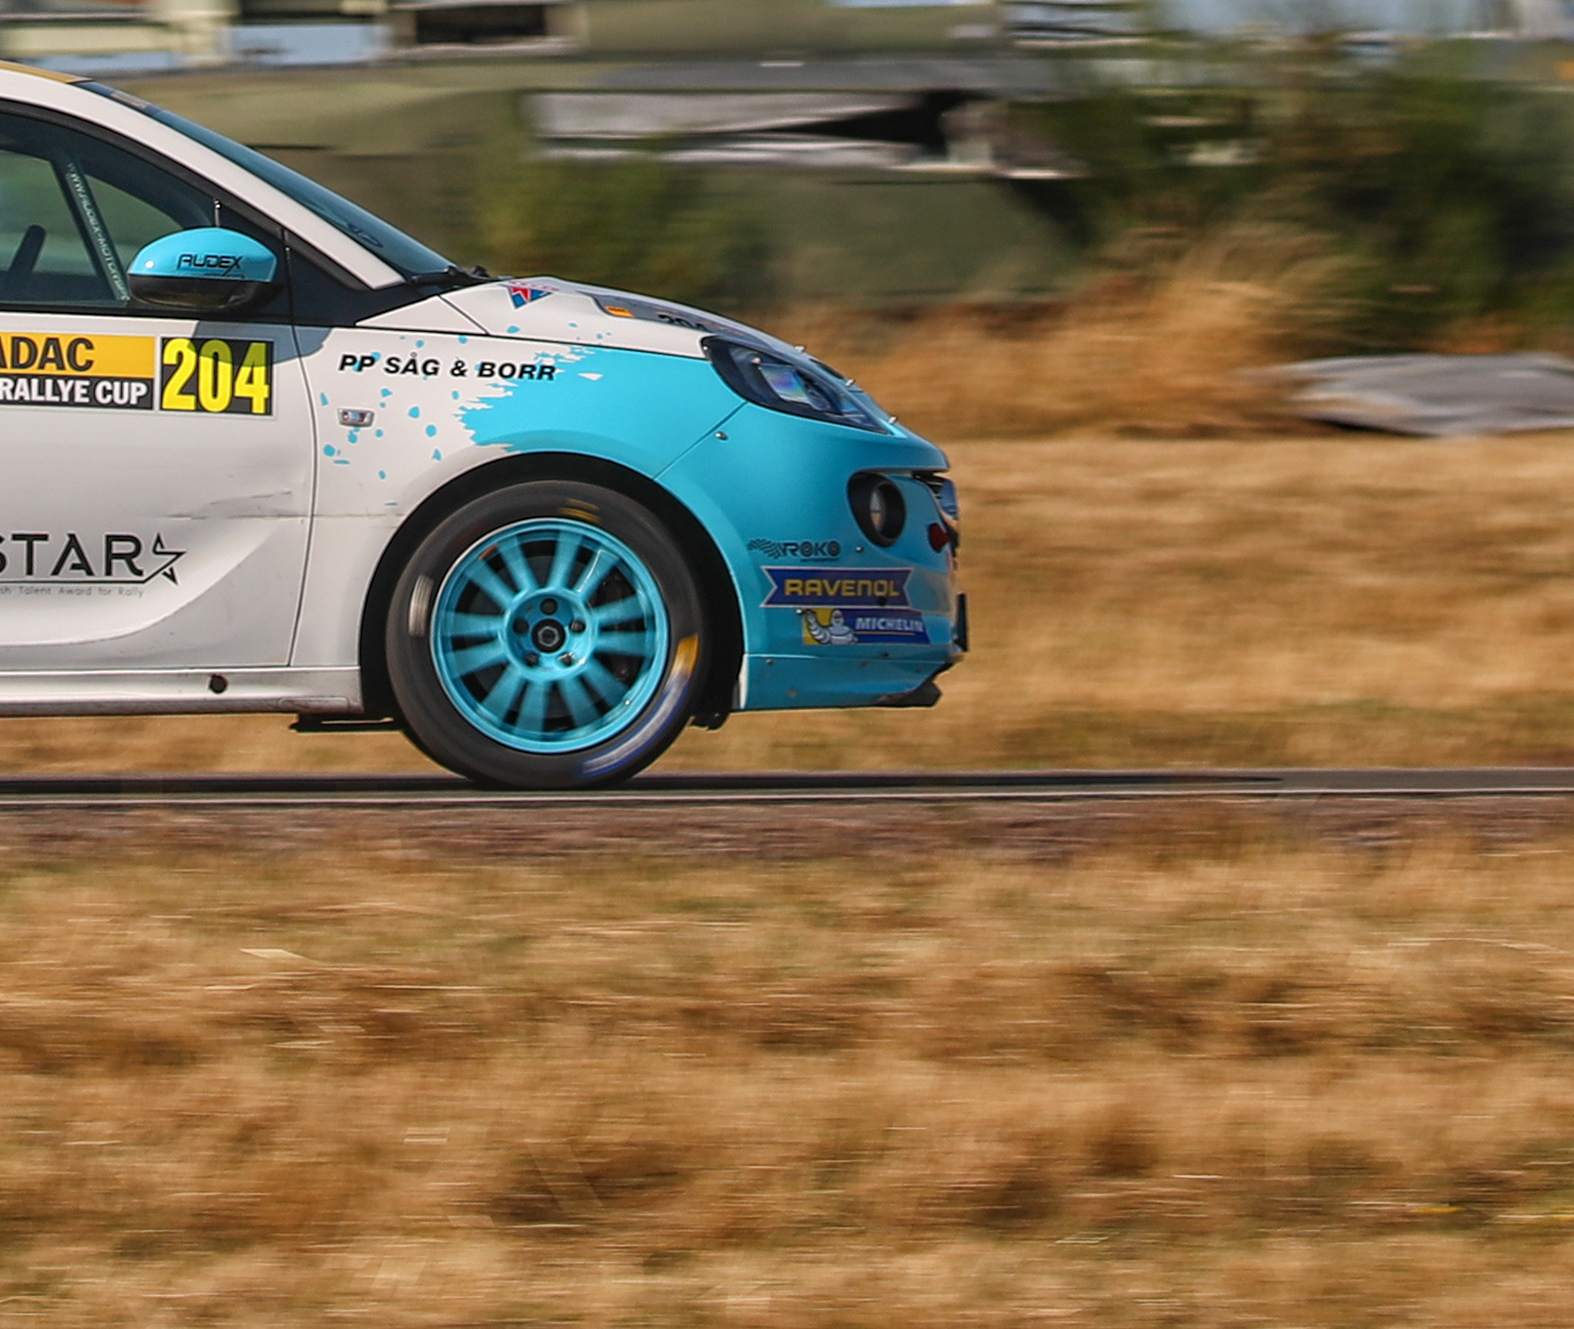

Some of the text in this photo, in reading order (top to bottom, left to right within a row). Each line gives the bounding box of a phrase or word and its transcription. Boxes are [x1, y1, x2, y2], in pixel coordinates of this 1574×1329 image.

[177, 253, 243, 276] AUDEX
[162, 337, 270, 414] 204
[338, 352, 556, 381] PP SÅG & BORR
[96, 380, 148, 406] CUP
[784, 579, 900, 597] RAVENOL
[855, 617, 925, 633] MICHELIN
